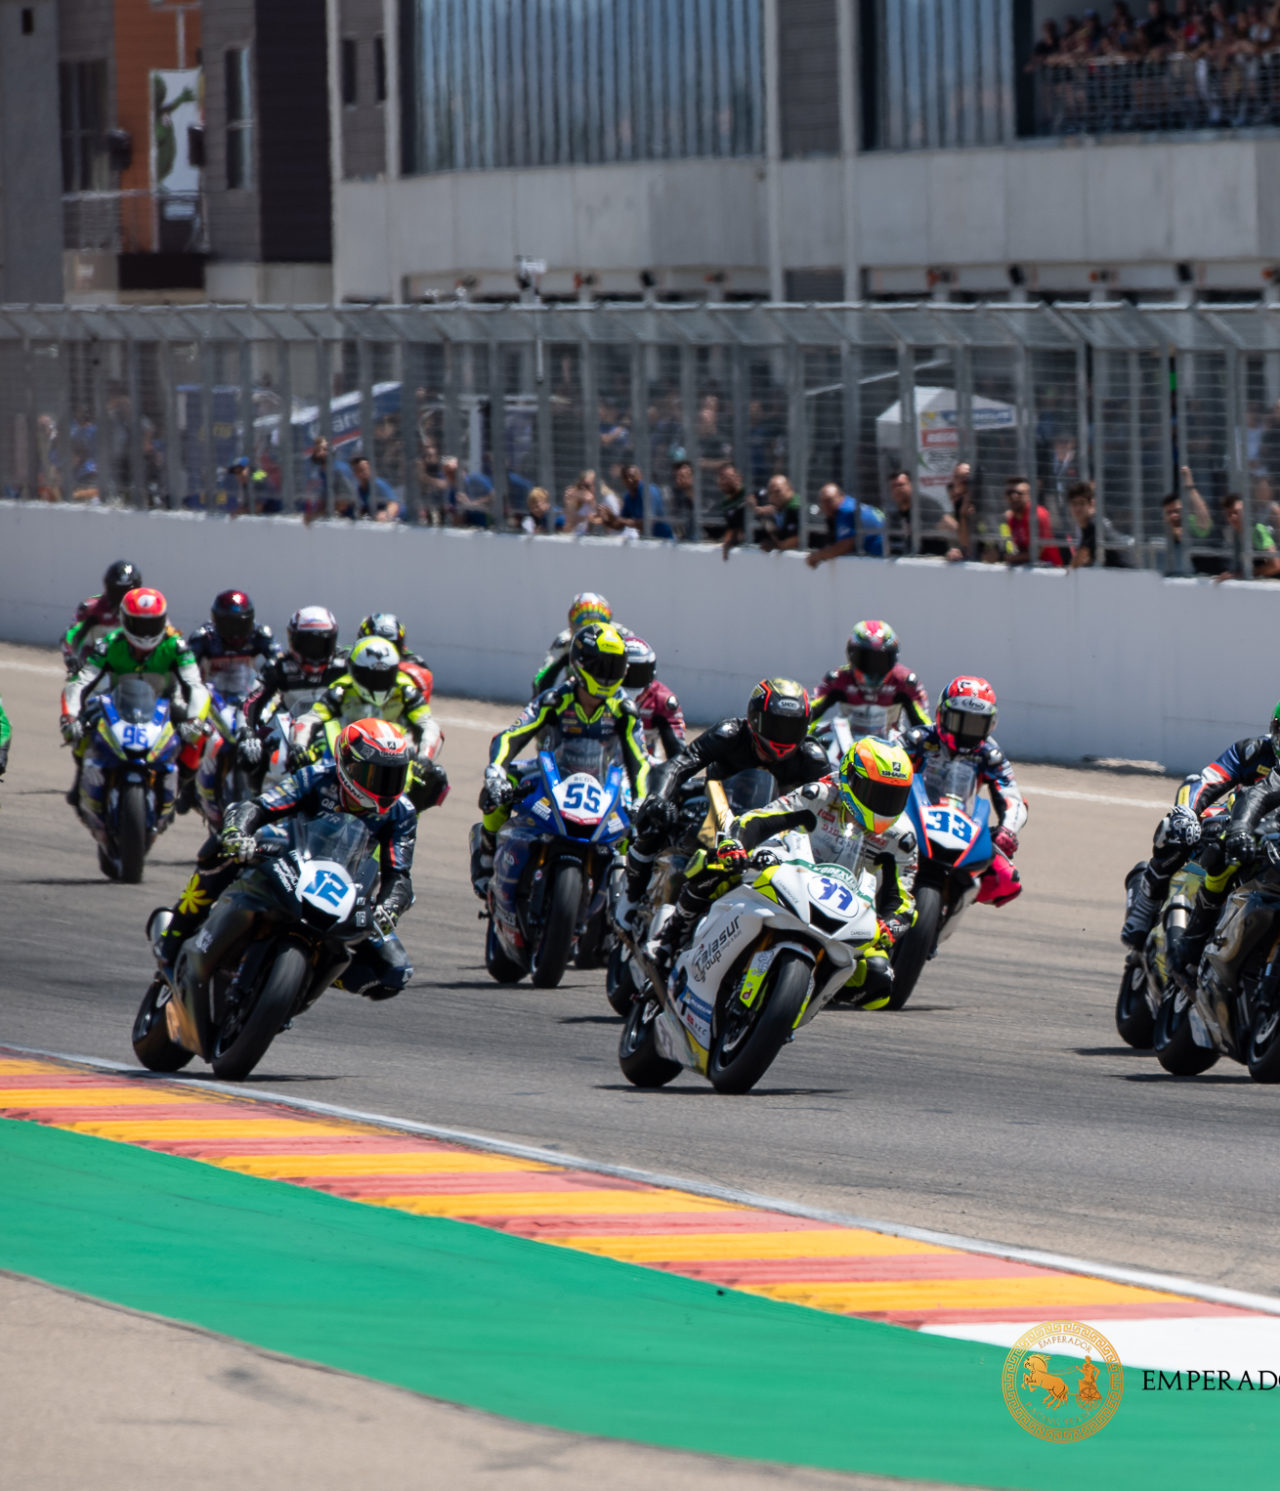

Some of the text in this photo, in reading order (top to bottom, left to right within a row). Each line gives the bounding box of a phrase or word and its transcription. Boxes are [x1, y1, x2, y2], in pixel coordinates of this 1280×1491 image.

[123, 725, 149, 748] 96
[563, 783, 601, 814] 55
[925, 810, 972, 843] 33
